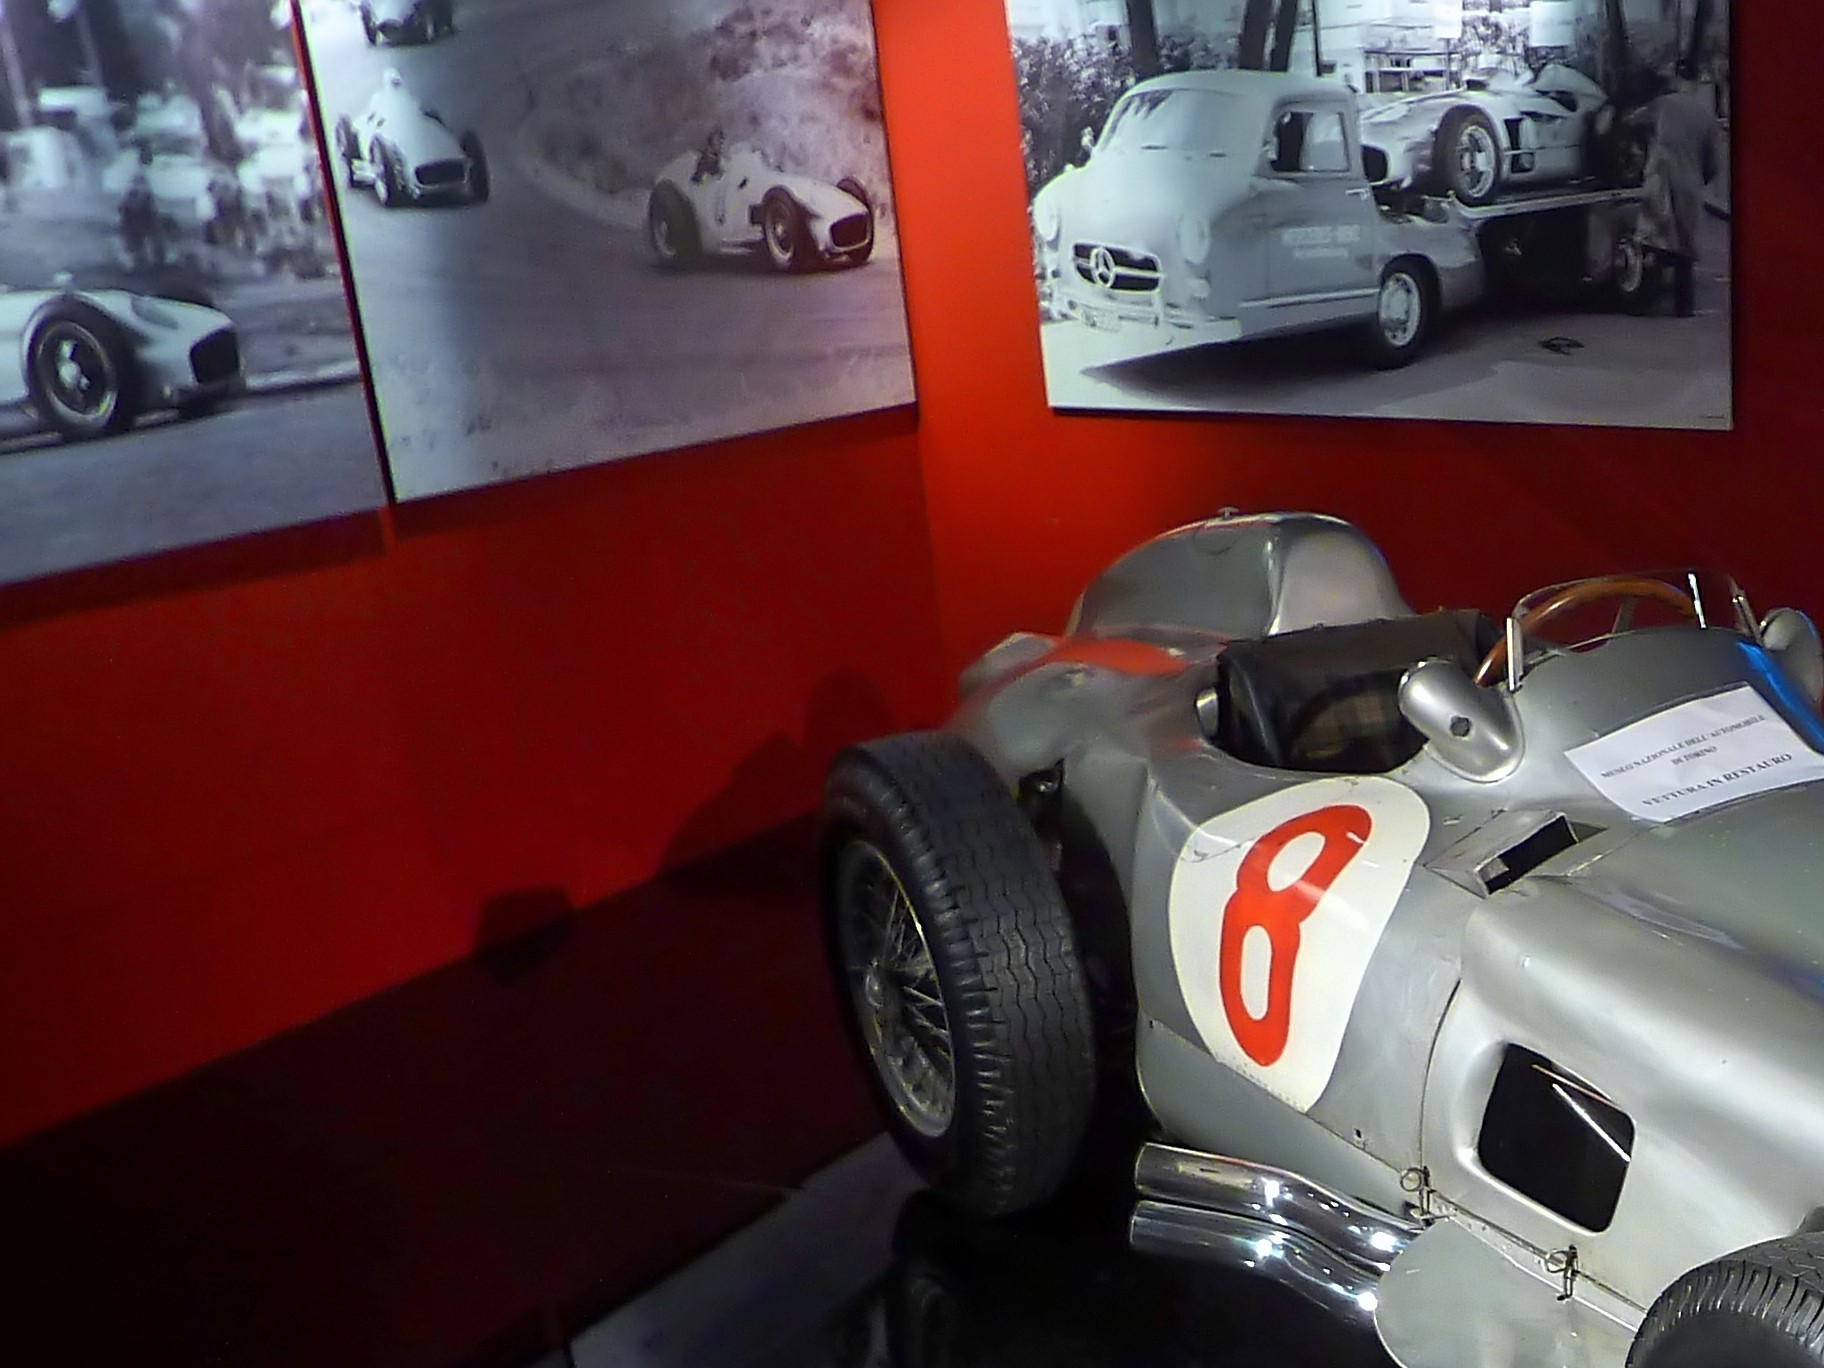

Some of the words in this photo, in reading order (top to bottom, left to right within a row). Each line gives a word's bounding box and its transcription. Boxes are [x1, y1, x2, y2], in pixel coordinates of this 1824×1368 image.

[1633, 741, 1685, 766] NAZIONALE
[1684, 745, 1718, 762] TORINO
[1641, 784, 1707, 806] VETTURA
[1706, 777, 1724, 788] IN
[1722, 753, 1793, 782] RESTAURO
[1219, 804, 1372, 1066] 8
